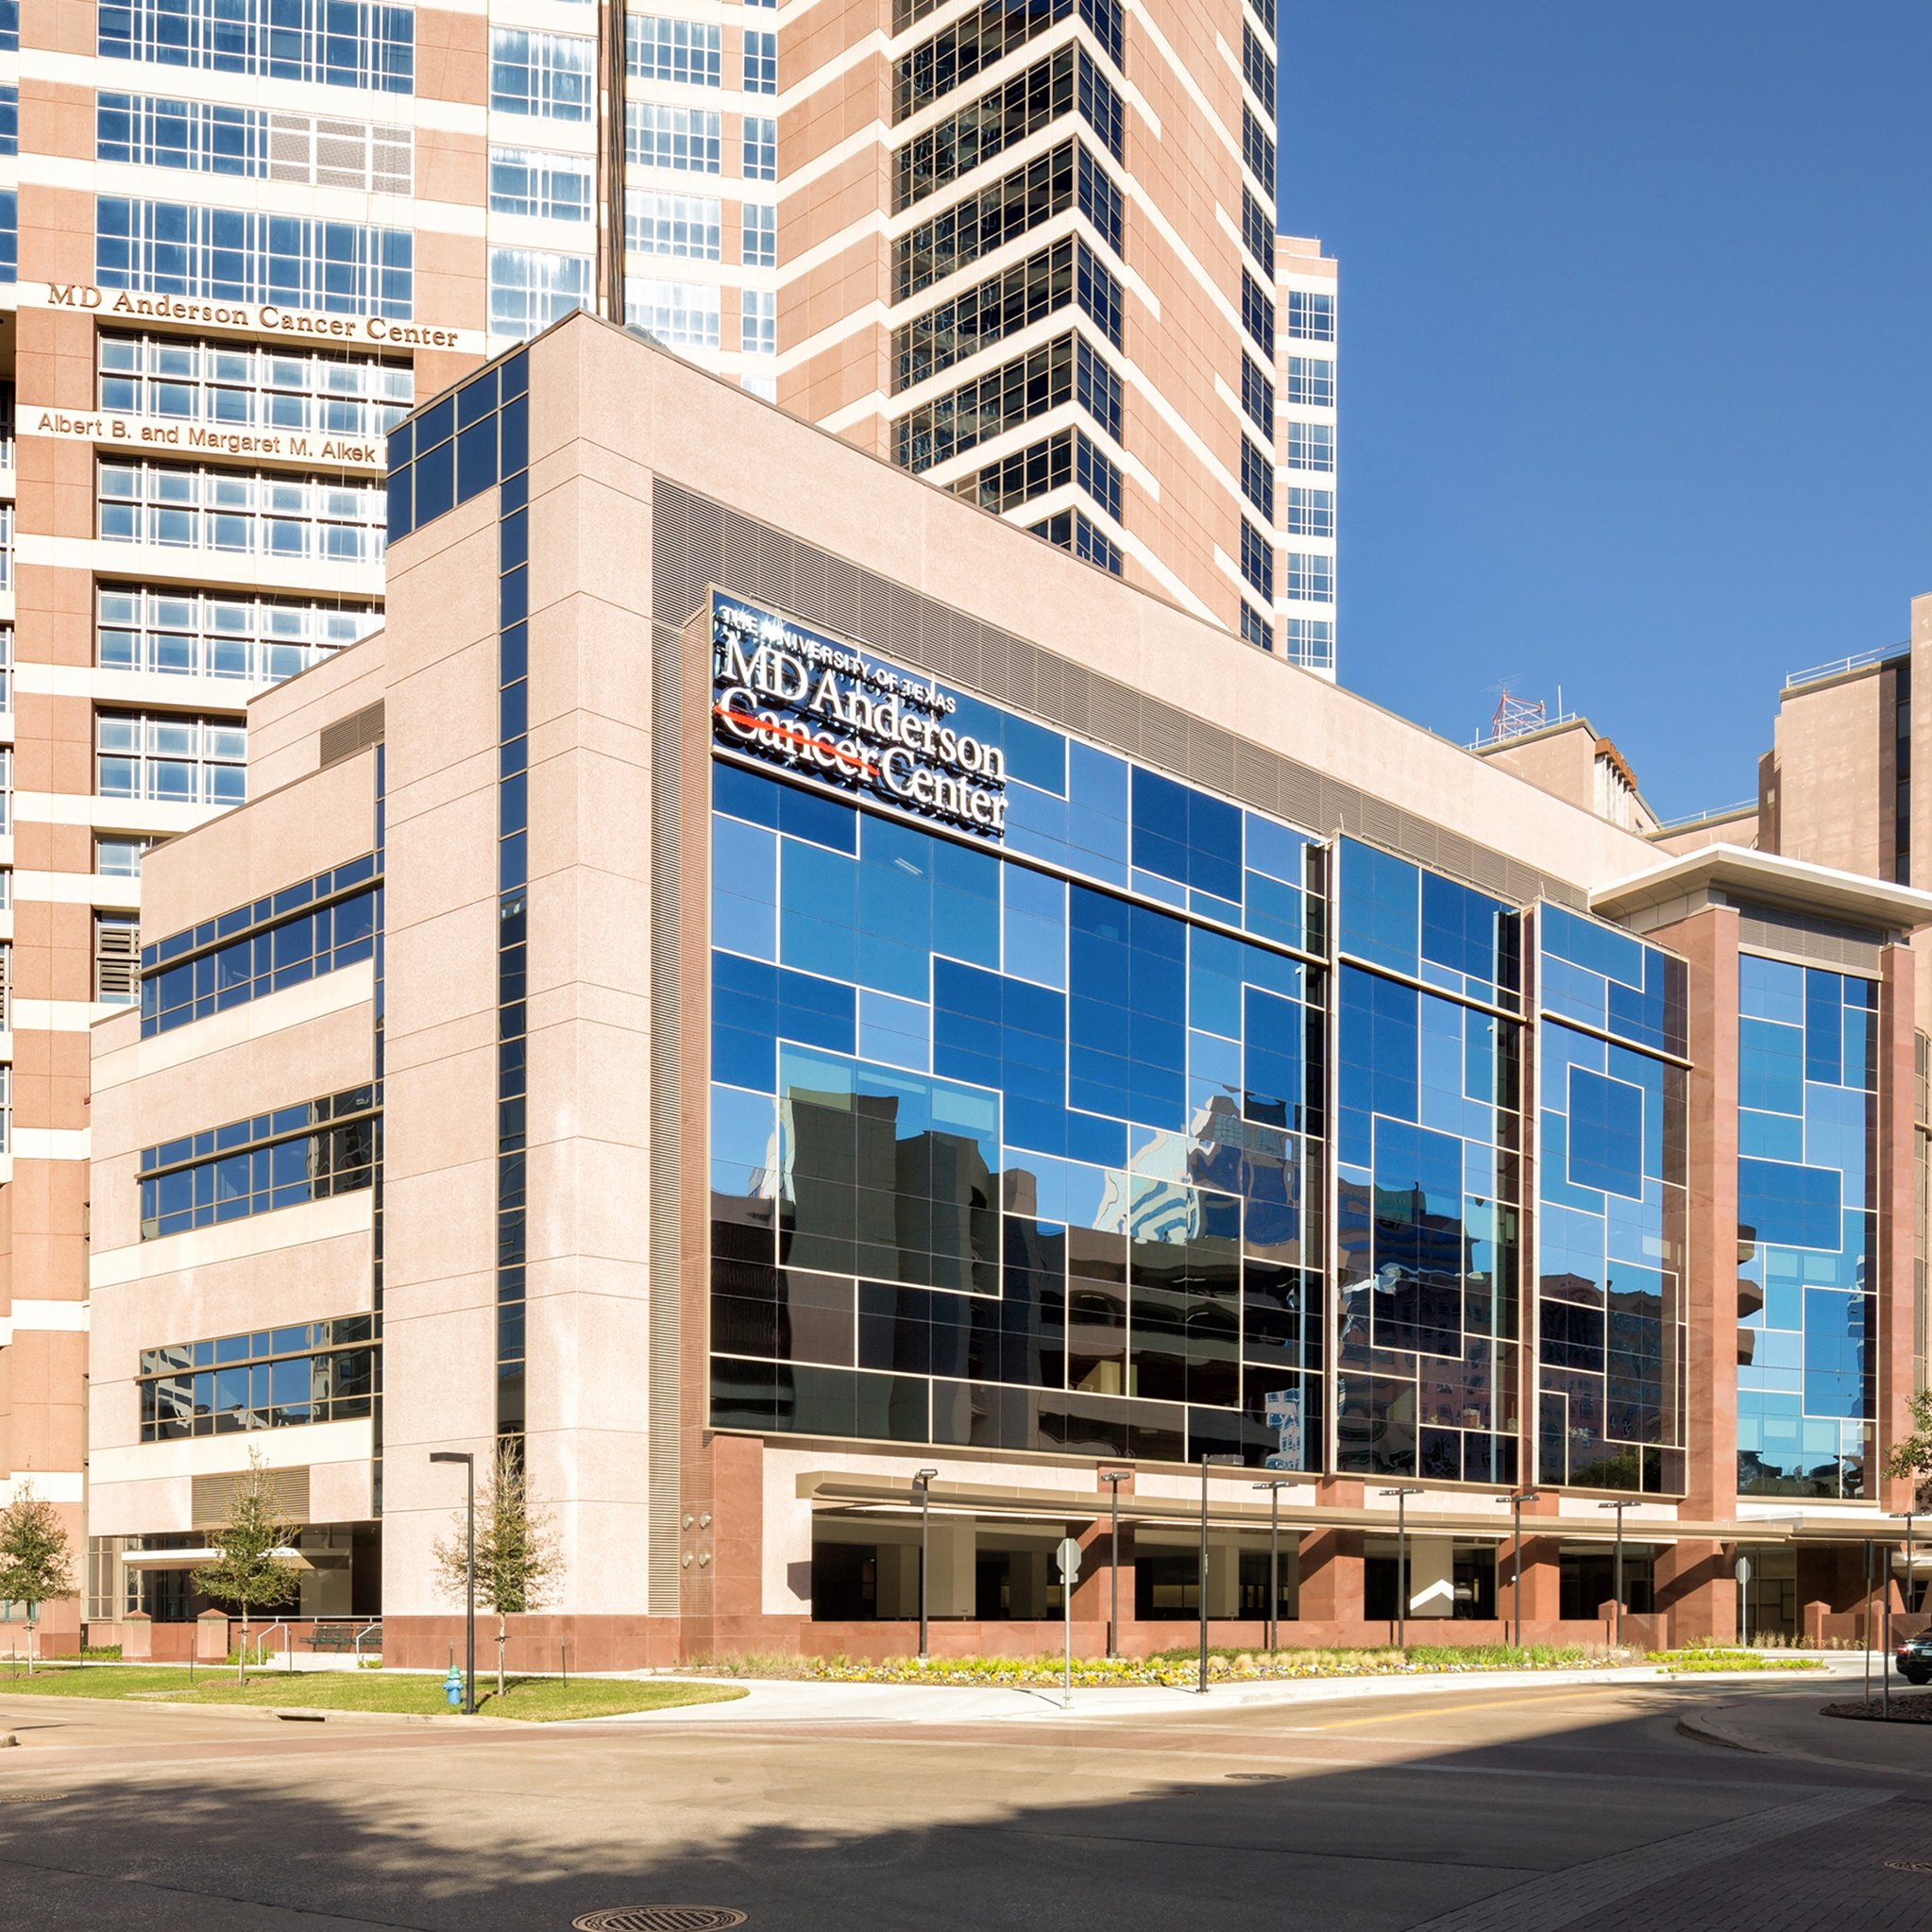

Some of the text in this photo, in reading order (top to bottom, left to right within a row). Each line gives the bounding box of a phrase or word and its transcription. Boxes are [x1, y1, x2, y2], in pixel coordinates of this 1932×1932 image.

[48, 281, 458, 347] MD Anderson Cancer Center
[38, 413, 102, 436] Albert
[111, 419, 131, 439] B.
[141, 426, 178, 444] and
[189, 427, 280, 453] Margaret
[289, 437, 313, 457] M.
[321, 440, 376, 463] Alkek
[718, 633, 1007, 783] MD Anderson
[719, 604, 957, 714] THE NIVERSITY OF TEXAS
[717, 686, 1008, 830] Cancer Center
